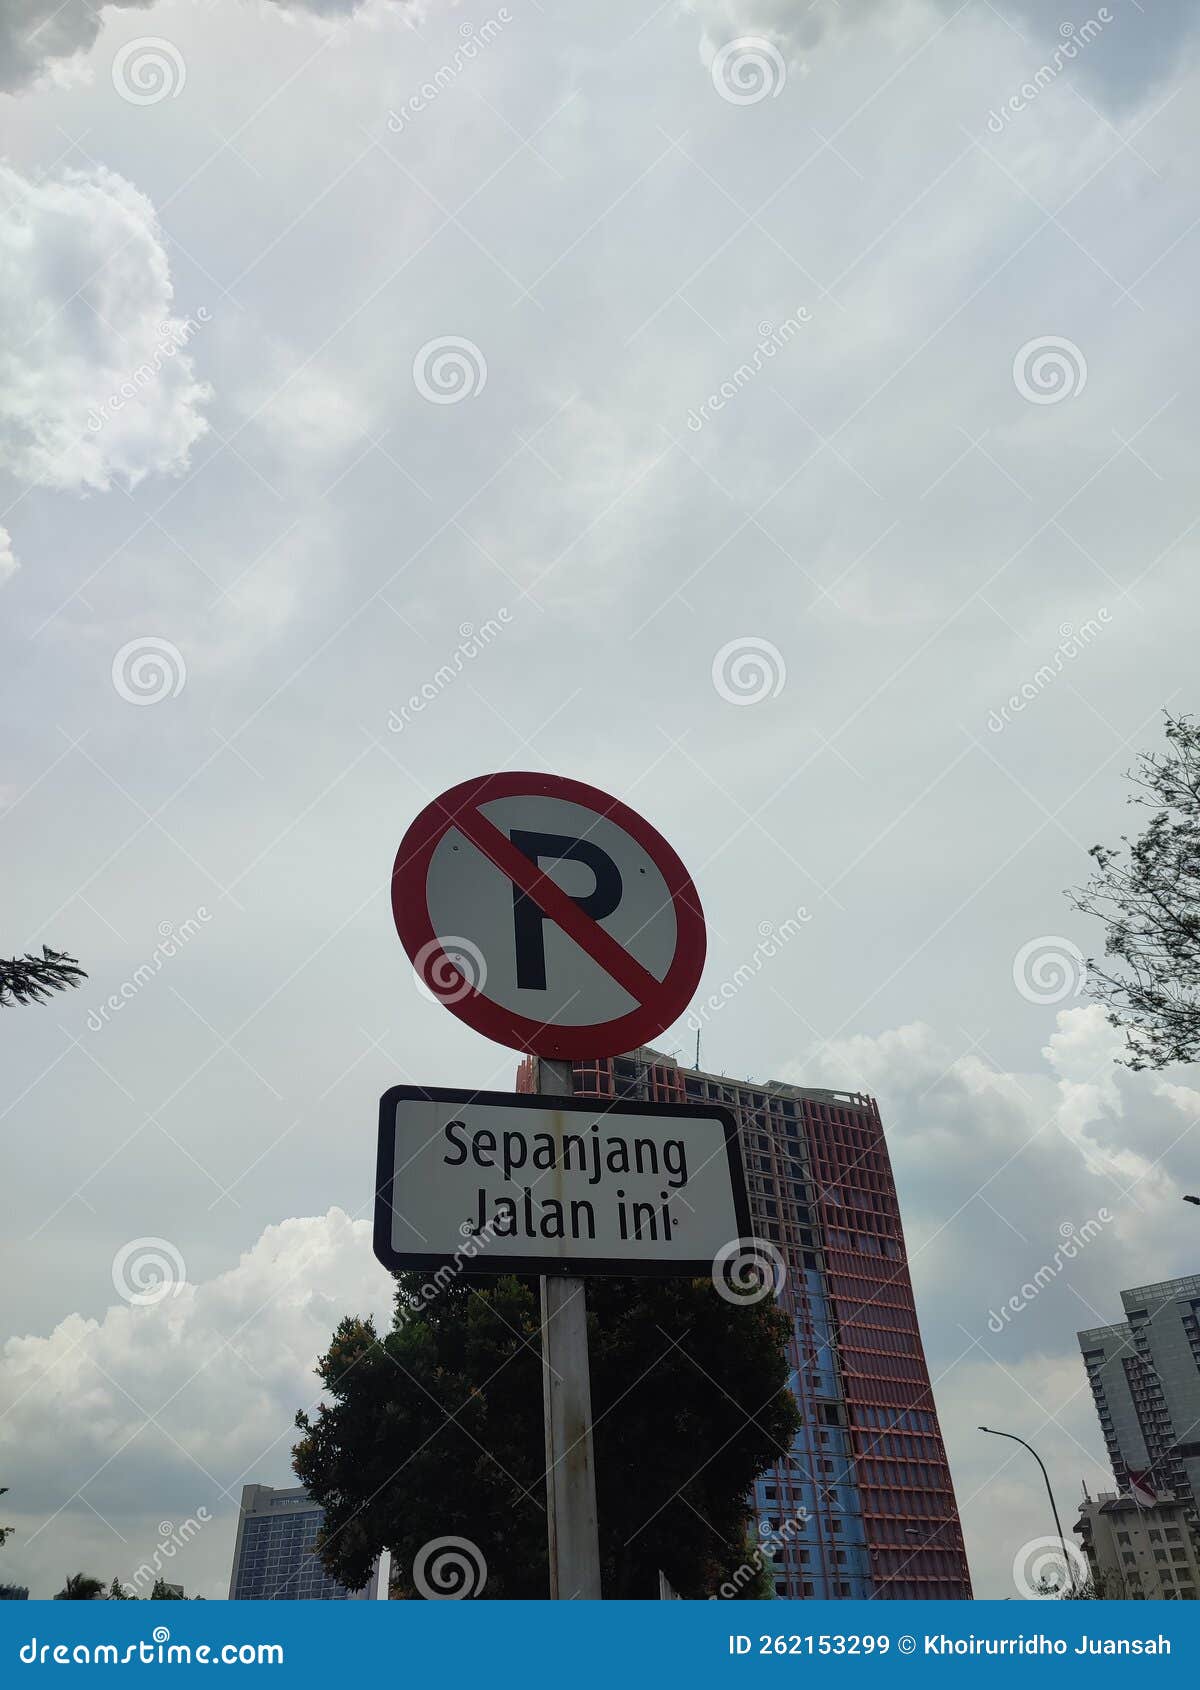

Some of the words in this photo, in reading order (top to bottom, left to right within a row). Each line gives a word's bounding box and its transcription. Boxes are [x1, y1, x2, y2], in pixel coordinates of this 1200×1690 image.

[509, 829, 623, 991] P
[443, 1120, 688, 1188] Sepanjang
[469, 1186, 596, 1239] Jalan
[616, 1189, 673, 1241] ini
